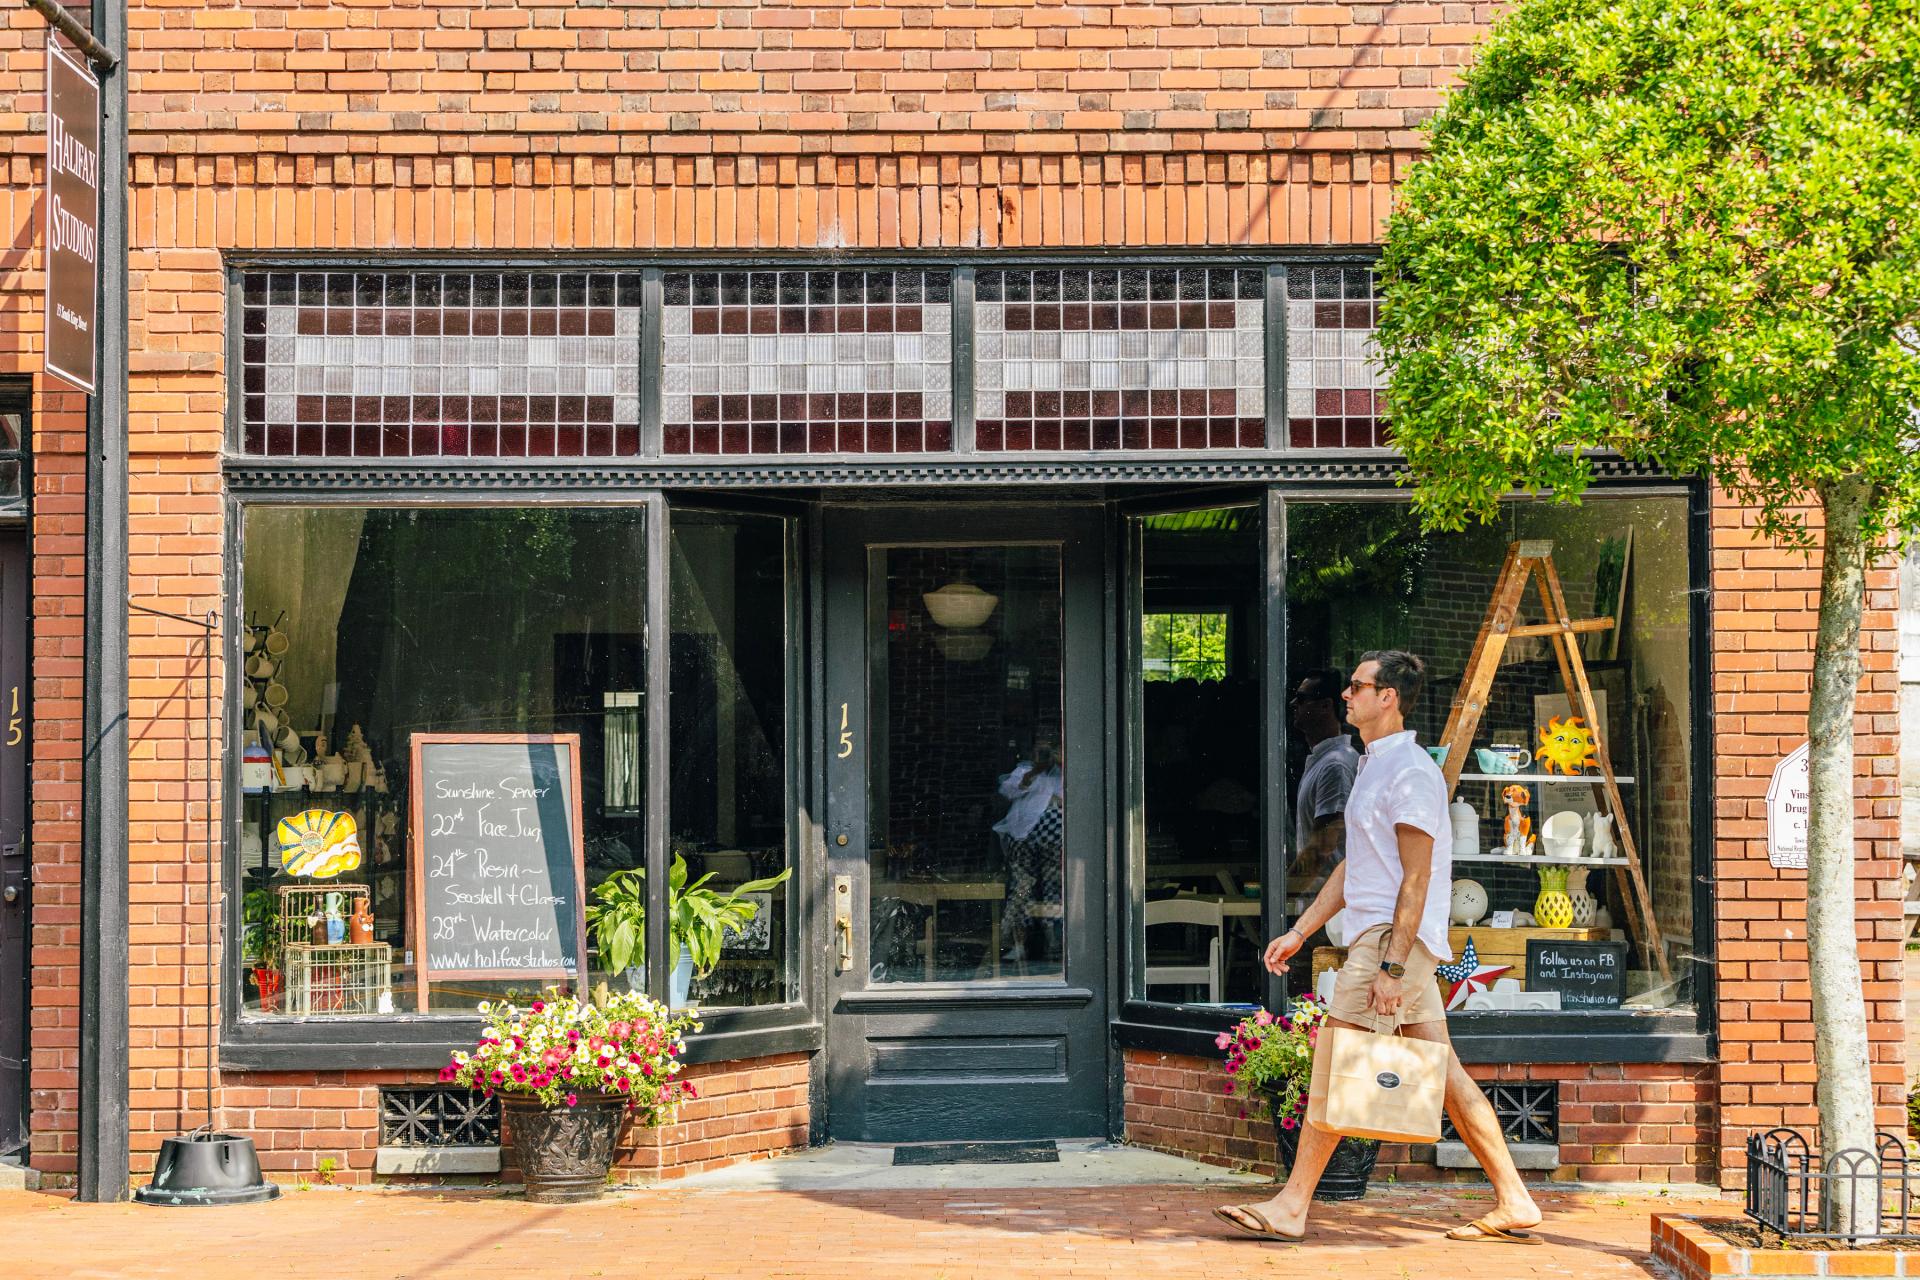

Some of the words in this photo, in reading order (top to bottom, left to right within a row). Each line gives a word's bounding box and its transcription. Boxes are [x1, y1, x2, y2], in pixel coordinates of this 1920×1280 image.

[1790, 788, 1810, 800] Vins
[1785, 802, 1808, 815] Drug
[478, 802, 508, 838] Face
[509, 807, 542, 842] Jug
[473, 847, 520, 879] Resin
[444, 883, 503, 906] Seashell
[519, 884, 566, 906] Glass
[470, 914, 553, 942] Watercolor
[1540, 949, 1568, 966] Follow
[1570, 958, 1582, 966] us
[1583, 958, 1596, 966] on
[1599, 953, 1615, 967] FB
[1539, 968, 1557, 978] and
[1560, 966, 1613, 985] Instagram
